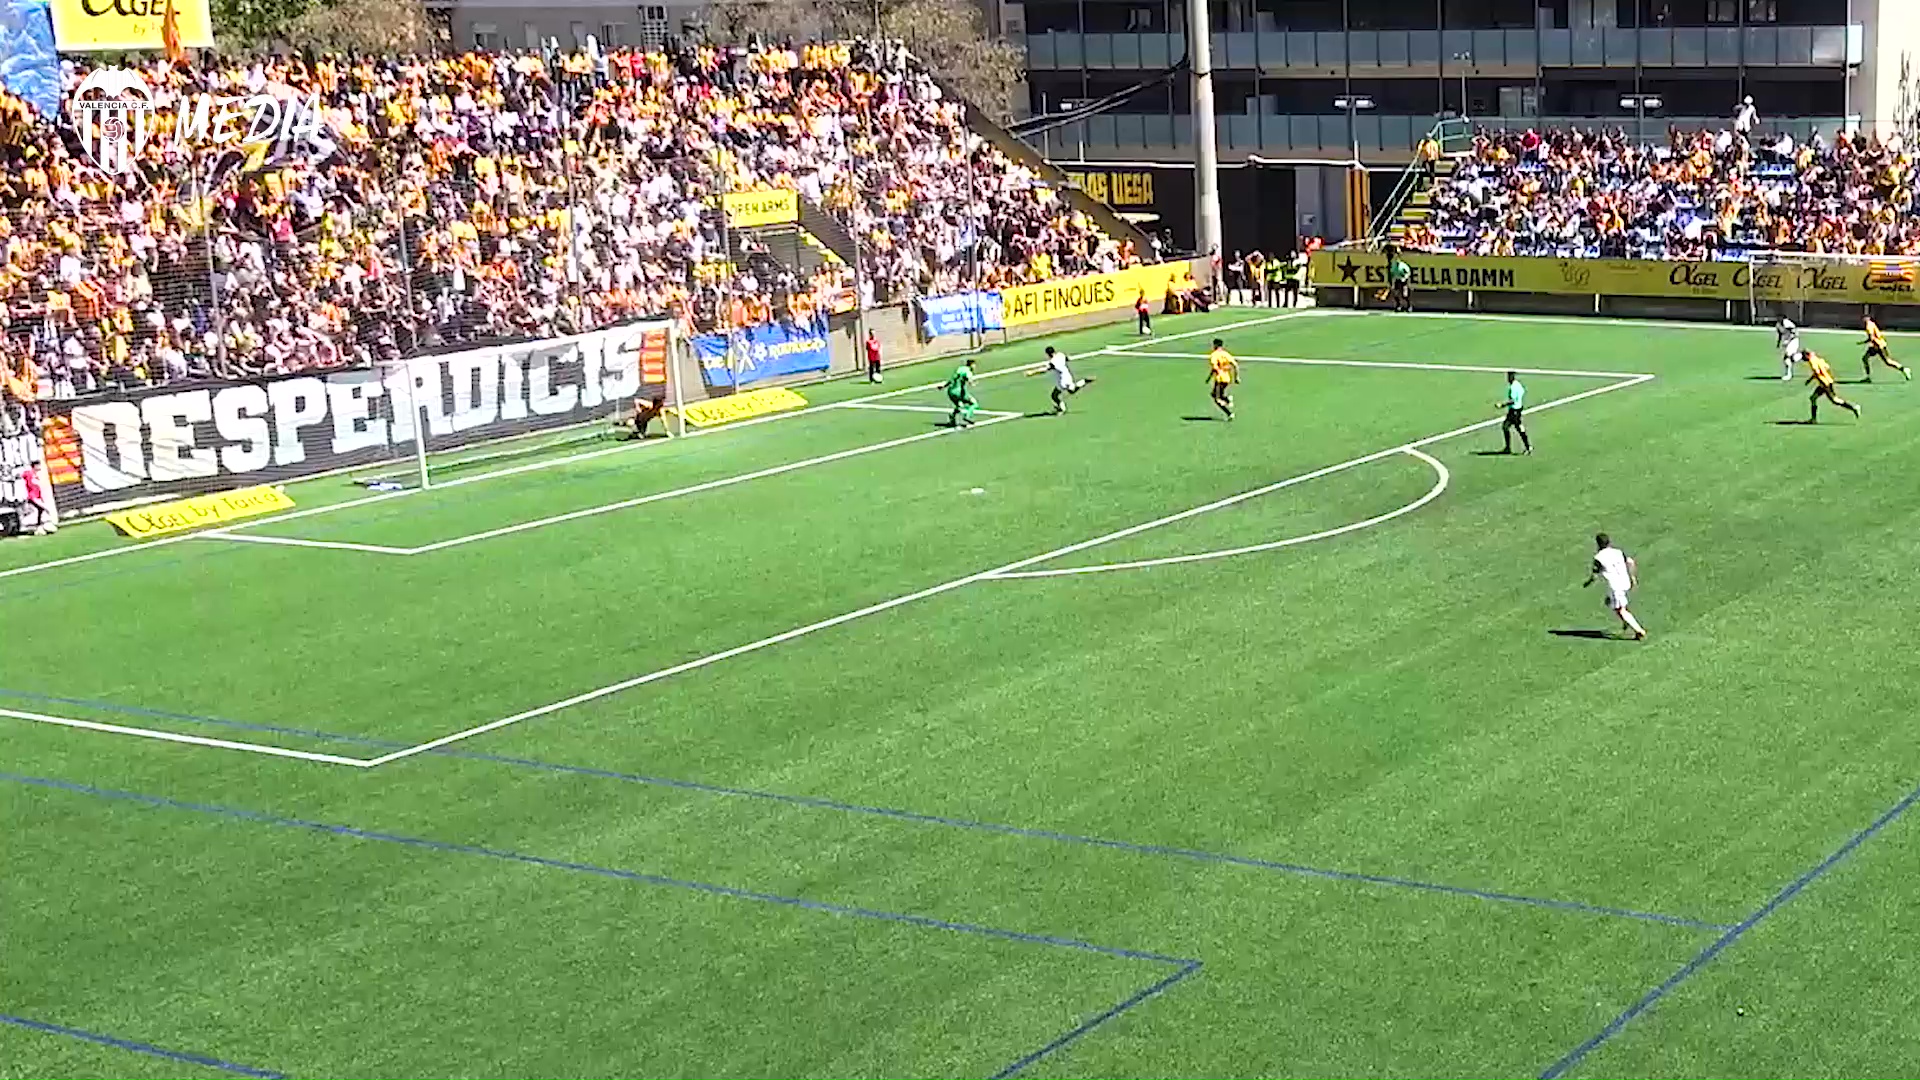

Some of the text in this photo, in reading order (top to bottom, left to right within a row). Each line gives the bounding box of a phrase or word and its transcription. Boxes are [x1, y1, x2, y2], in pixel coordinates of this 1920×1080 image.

[1364, 265, 1515, 288] ESELLA DAMM
[1013, 291, 1039, 318] AFI
[1043, 278, 1115, 312] FINQUES
[71, 325, 643, 494] DESPERDICIS
